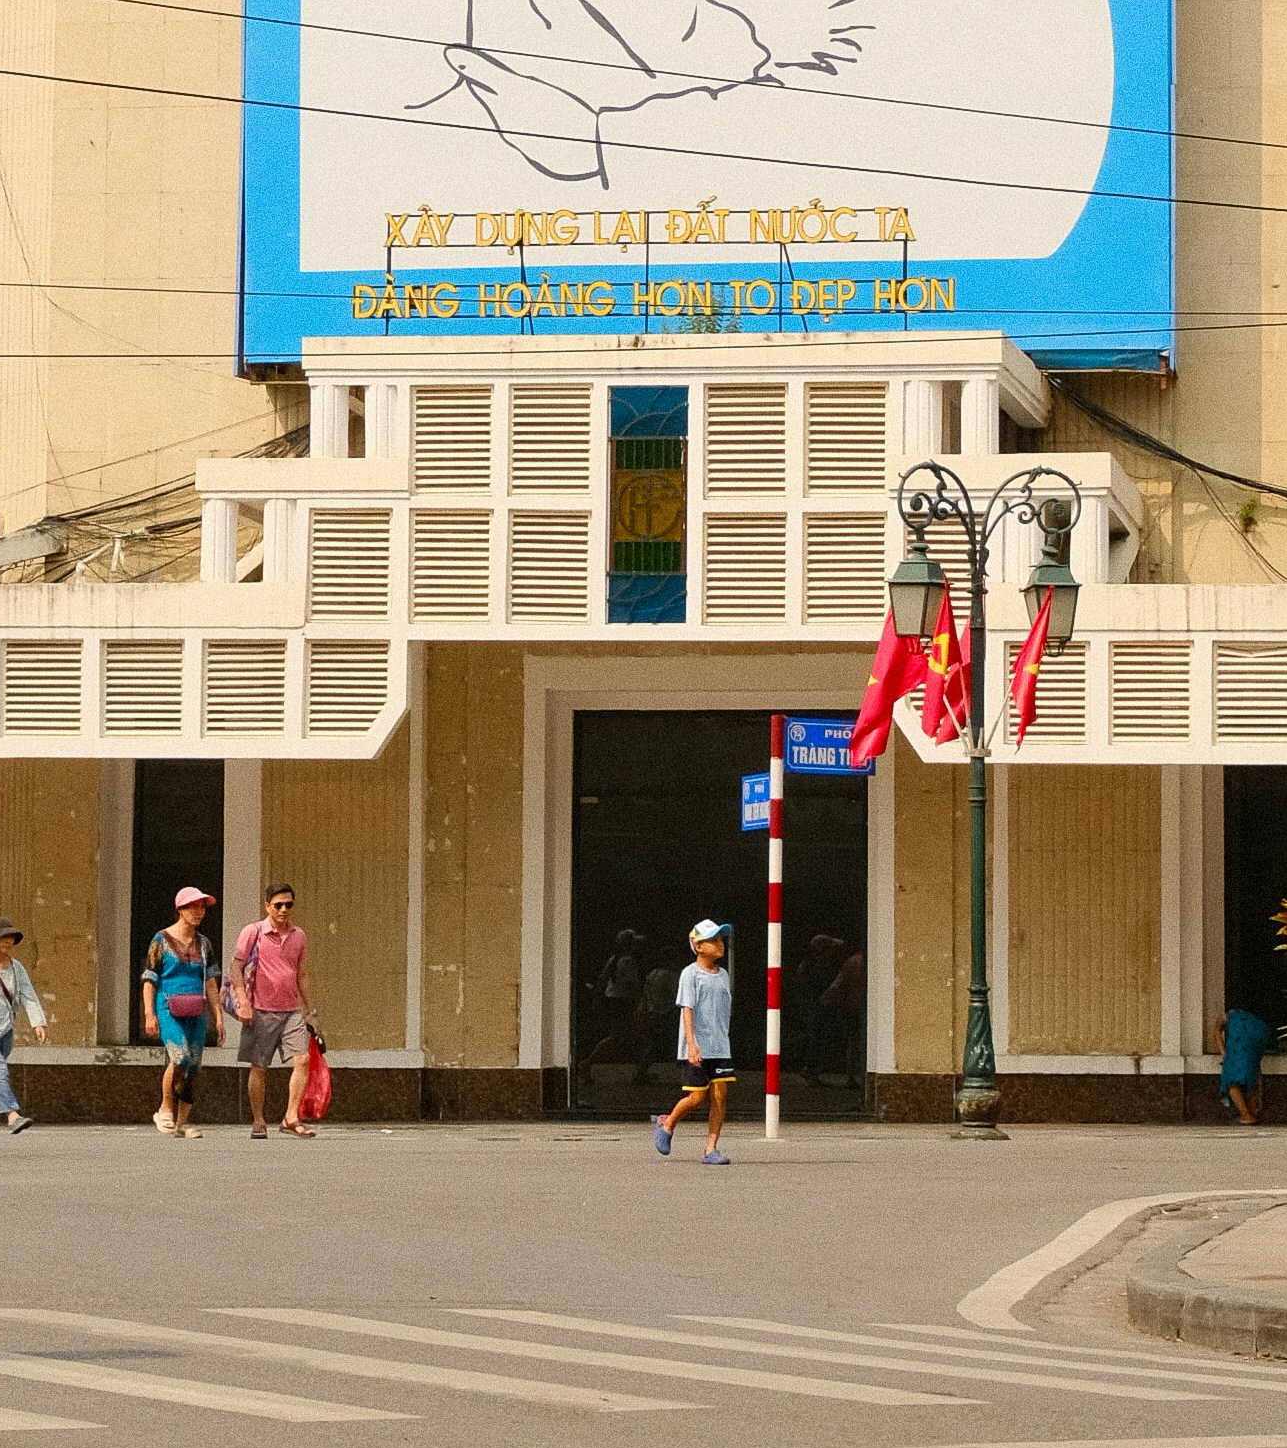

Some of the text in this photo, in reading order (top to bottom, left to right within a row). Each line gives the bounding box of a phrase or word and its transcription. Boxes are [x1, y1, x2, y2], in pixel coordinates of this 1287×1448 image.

[385, 196, 916, 255] XÂY DỰNG LẠI ĐẤT NƯỚC TA
[352, 272, 955, 323] ĐÀNG HOÀNG HƠN TO ĐẸP HƠN
[792, 743, 836, 765] TRÀNG
